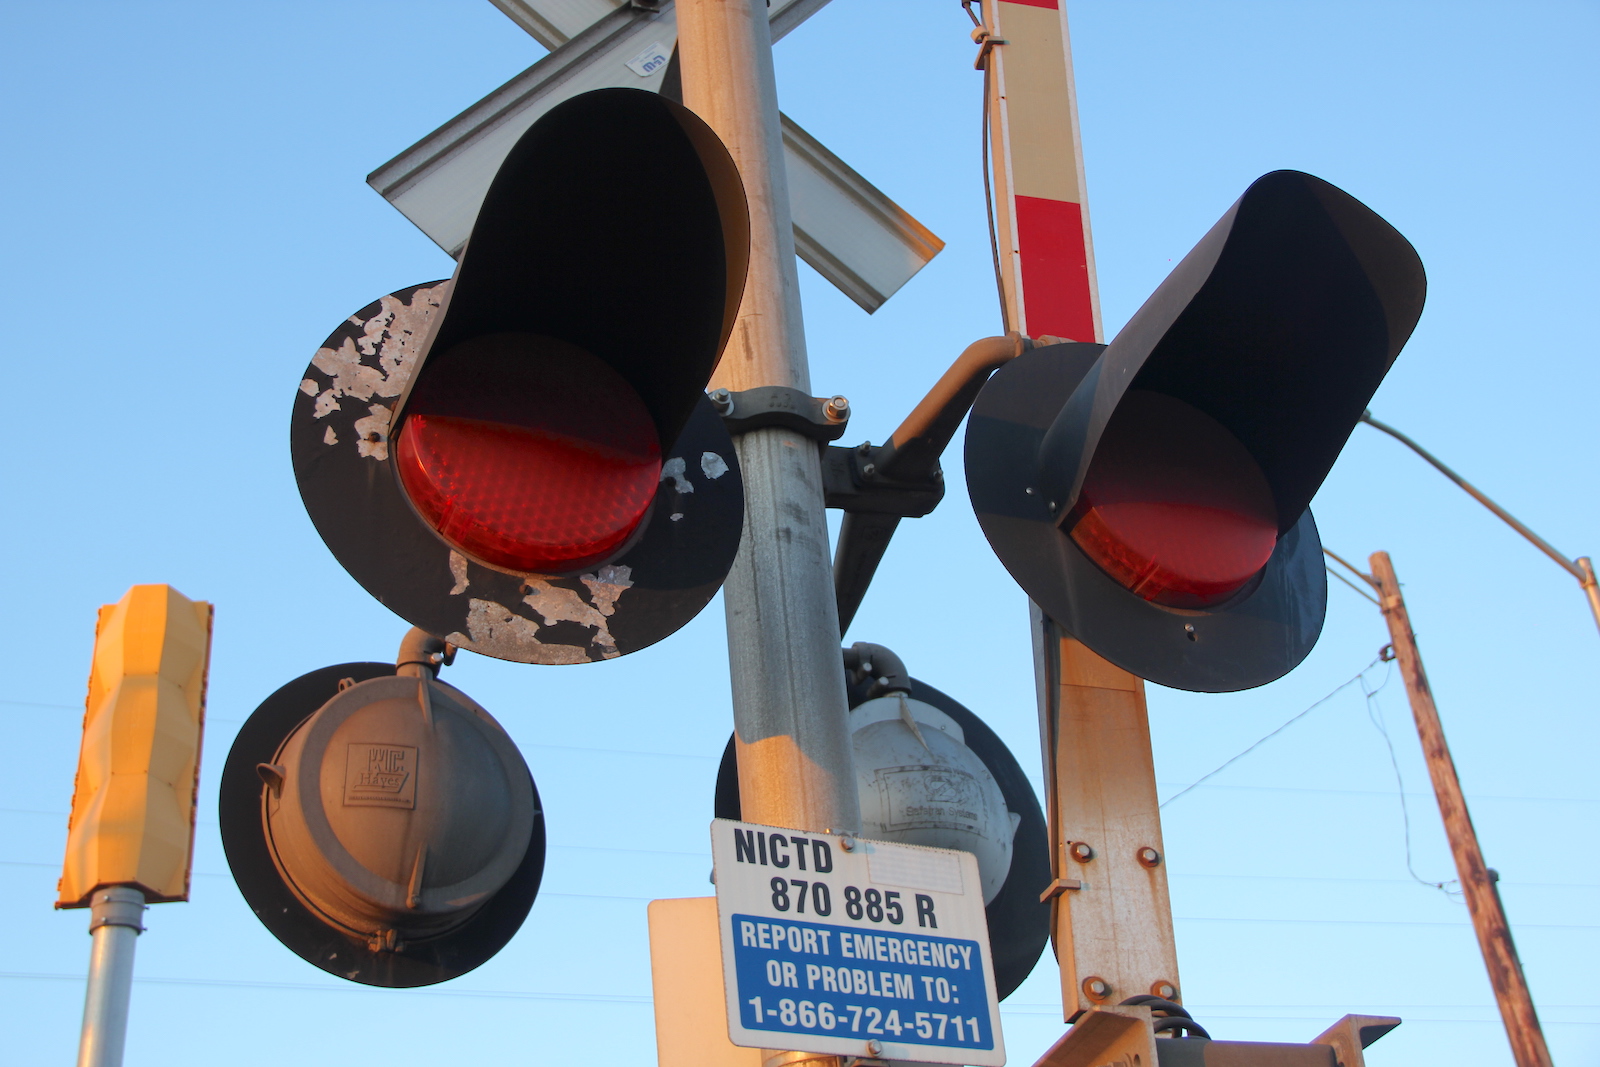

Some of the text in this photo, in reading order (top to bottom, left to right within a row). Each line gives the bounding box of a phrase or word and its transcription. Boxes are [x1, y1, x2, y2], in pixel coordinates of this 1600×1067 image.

[359, 772, 401, 789] Hayes
[734, 828, 833, 874] NICTD
[770, 876, 938, 929] 870 885 R
[740, 920, 972, 971] REPORT EMERGENCY
[766, 959, 960, 1004] OR PROBLEM TO:
[748, 995, 981, 1043] 1-866-724-5711
